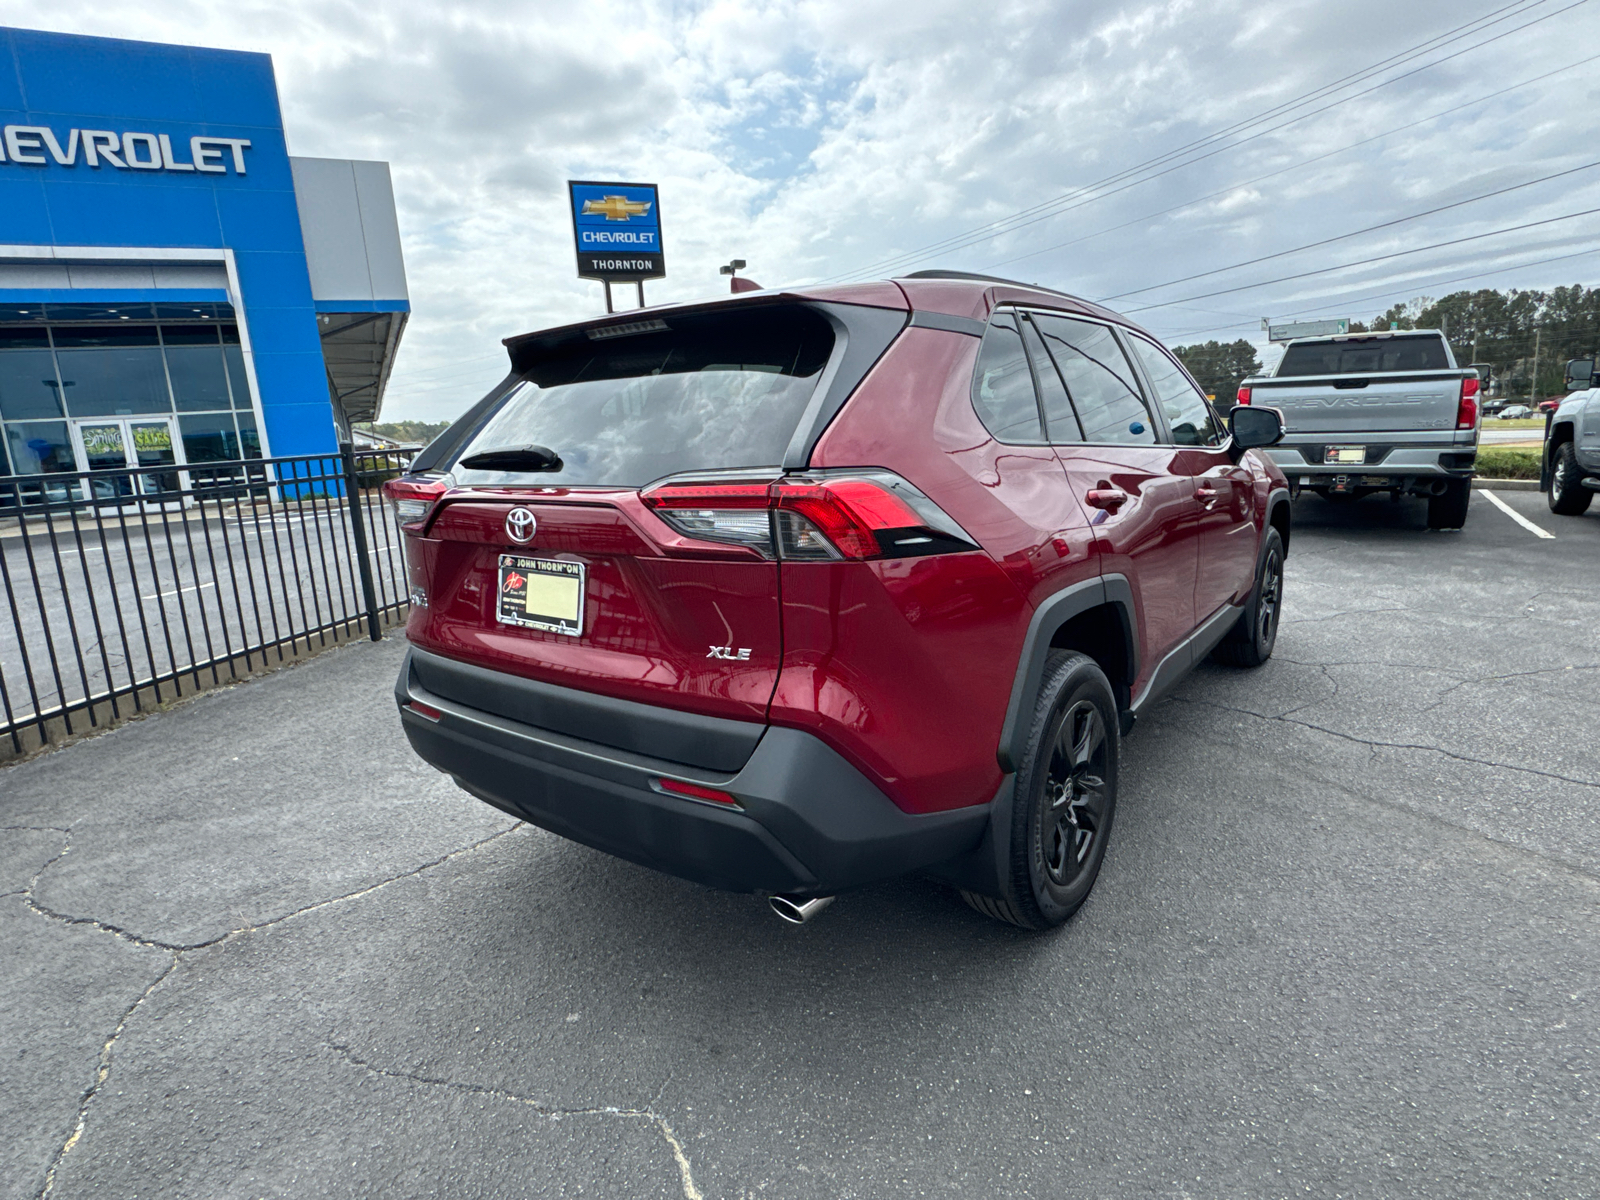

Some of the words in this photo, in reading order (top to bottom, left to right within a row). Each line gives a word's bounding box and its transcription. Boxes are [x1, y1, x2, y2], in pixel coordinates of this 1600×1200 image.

[0, 124, 252, 174] EVROLET
[582, 231, 655, 244] CHEVROLET
[592, 259, 653, 270] THORNTON
[1265, 393, 1444, 410] CHEVROLET
[84, 430, 122, 447] Spring
[516, 558, 536, 569] JOHN
[706, 645, 752, 661] XLE
